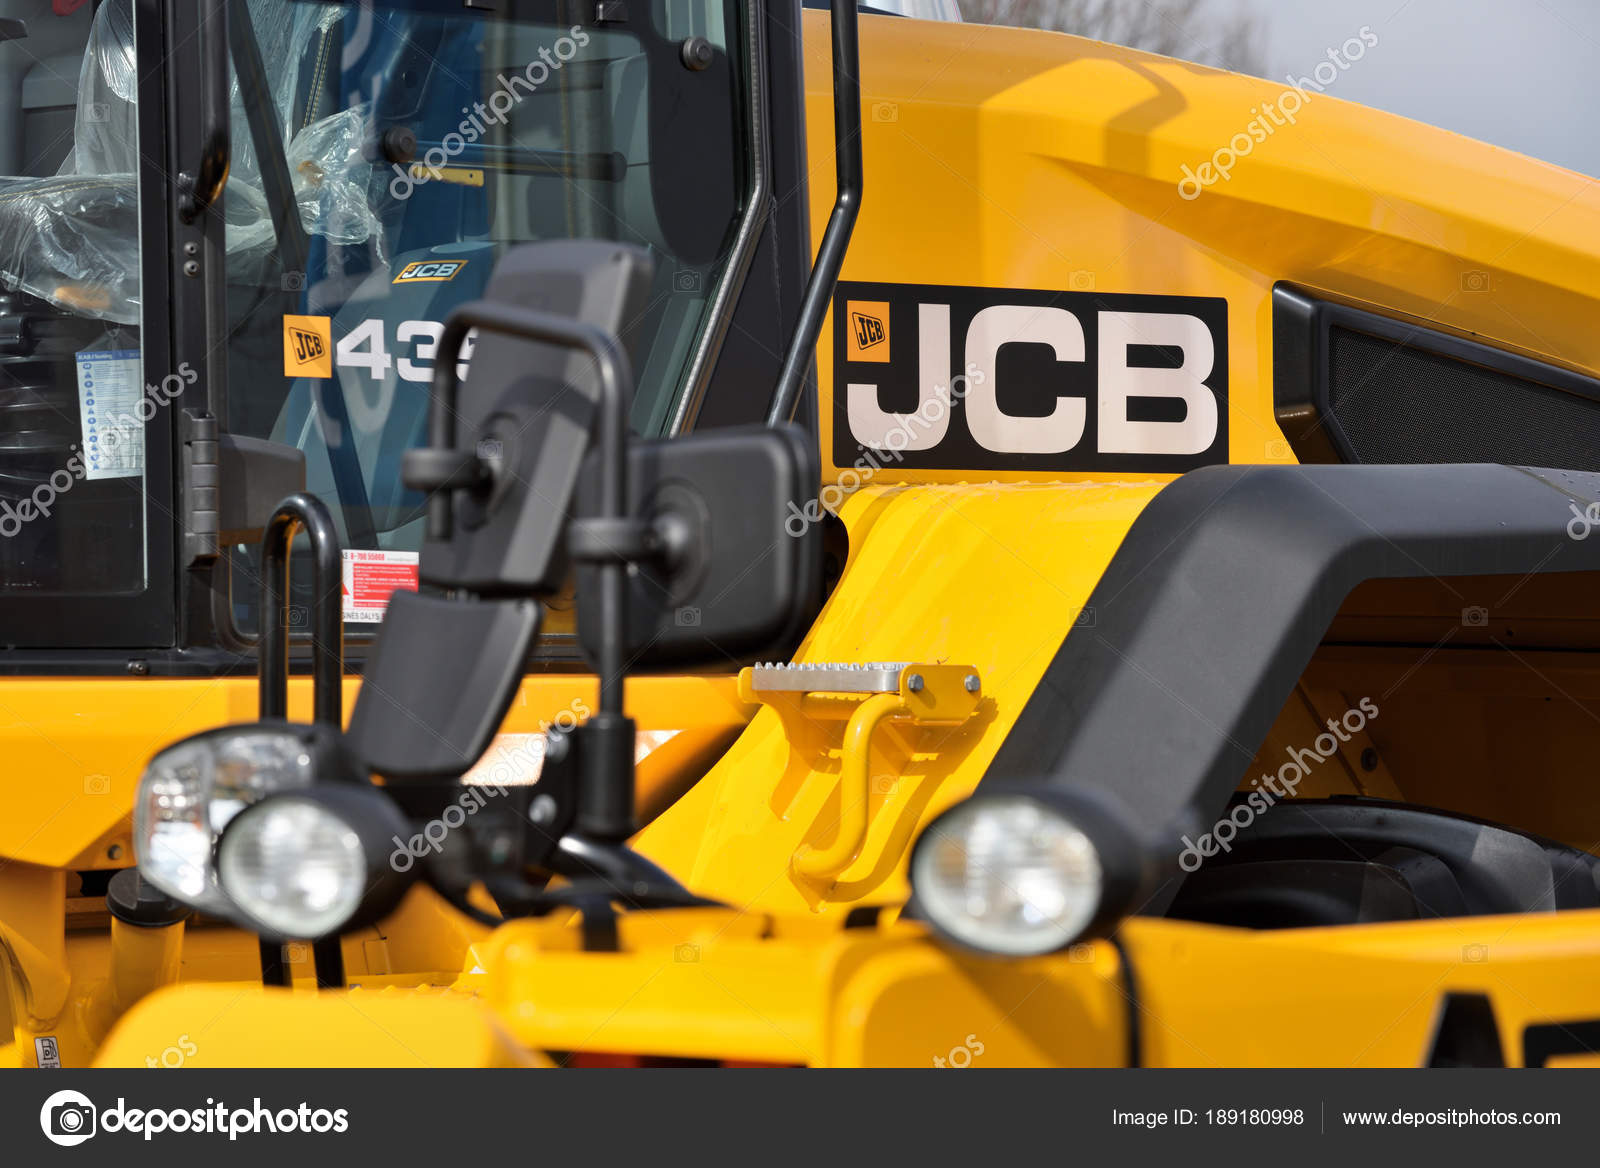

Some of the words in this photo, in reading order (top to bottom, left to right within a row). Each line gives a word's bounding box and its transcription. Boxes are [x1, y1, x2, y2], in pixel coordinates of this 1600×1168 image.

[402, 263, 459, 278] JCB
[858, 316, 883, 345] JCB
[296, 332, 323, 361] JCB
[847, 302, 1218, 455] JCB
